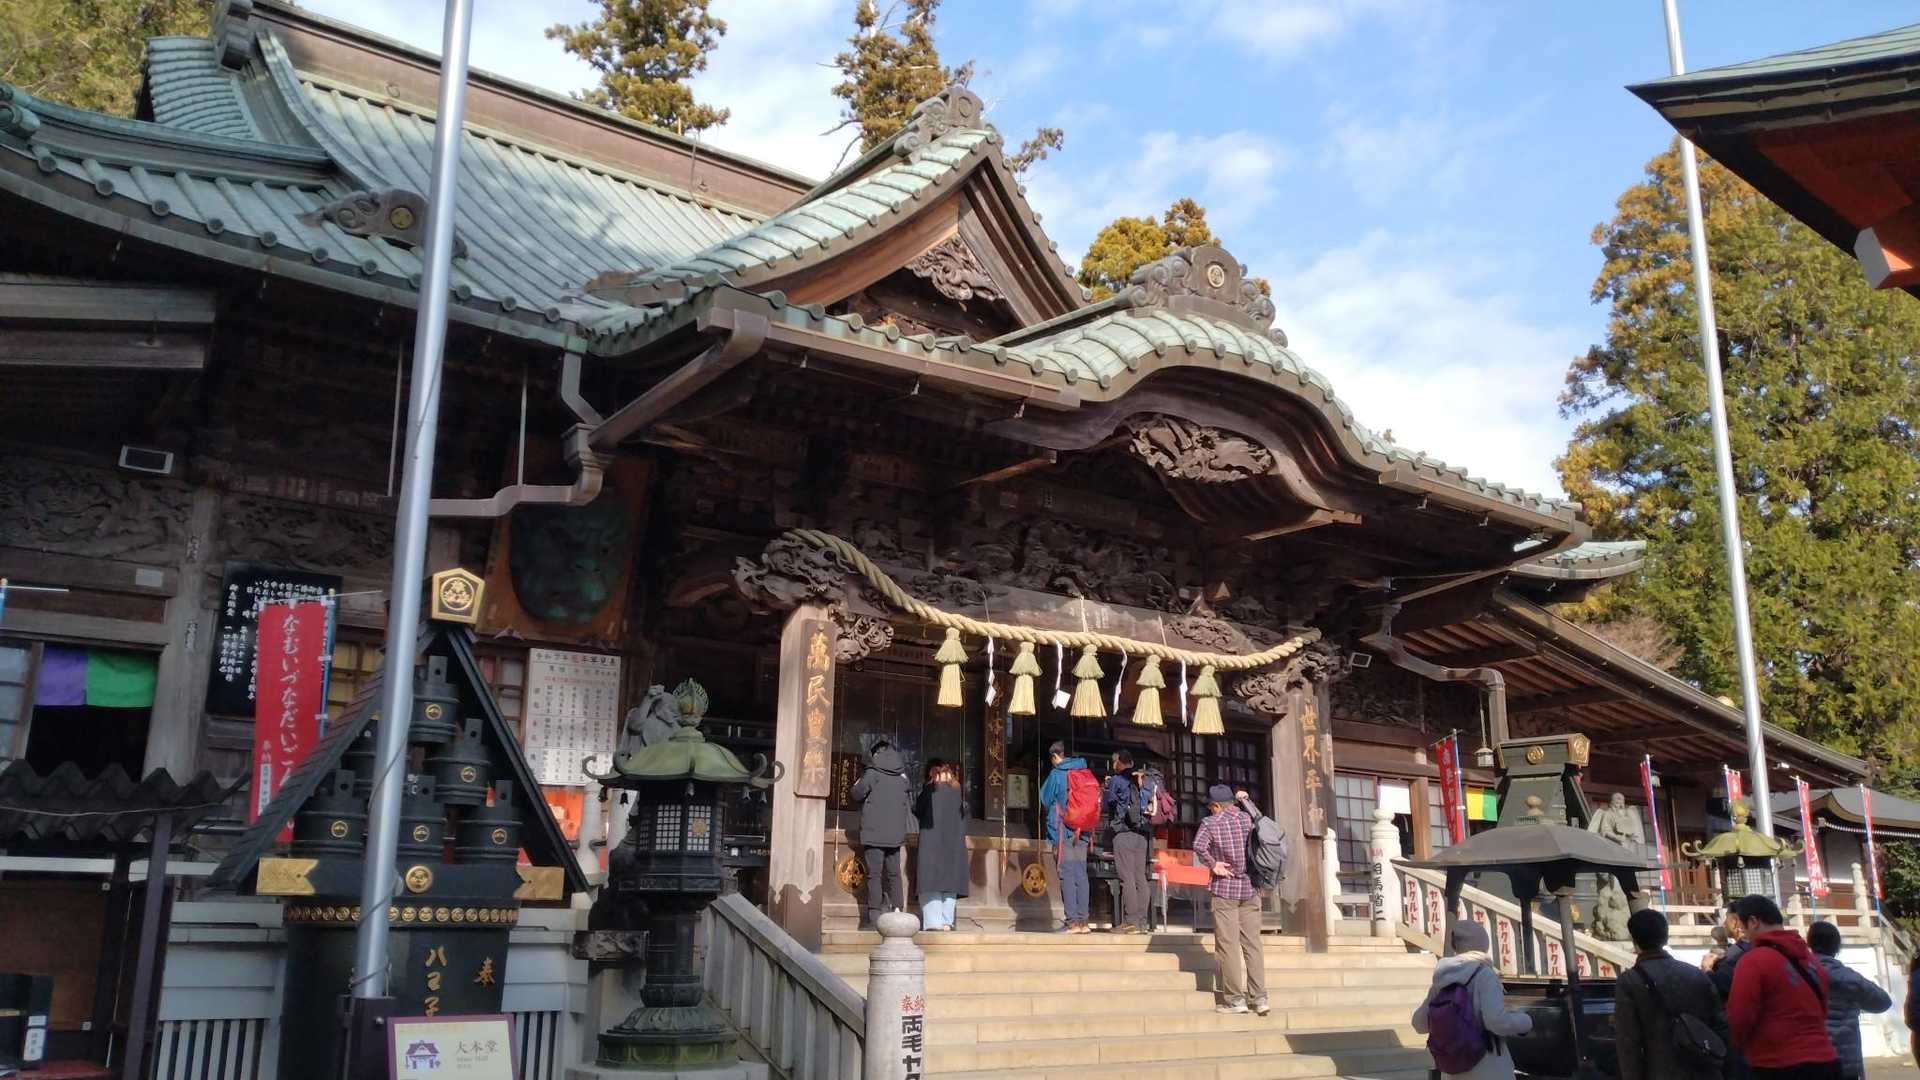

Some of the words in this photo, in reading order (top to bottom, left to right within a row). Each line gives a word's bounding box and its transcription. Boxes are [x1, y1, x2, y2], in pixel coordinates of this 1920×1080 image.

[1300, 702, 1324, 822] 世界平和
[1407, 880, 1419, 924] ヤクルト
[1429, 890, 1441, 934] ヤクルト
[1499, 921, 1512, 966] ヤクルト
[456, 1040, 499, 1055] 大本堂
